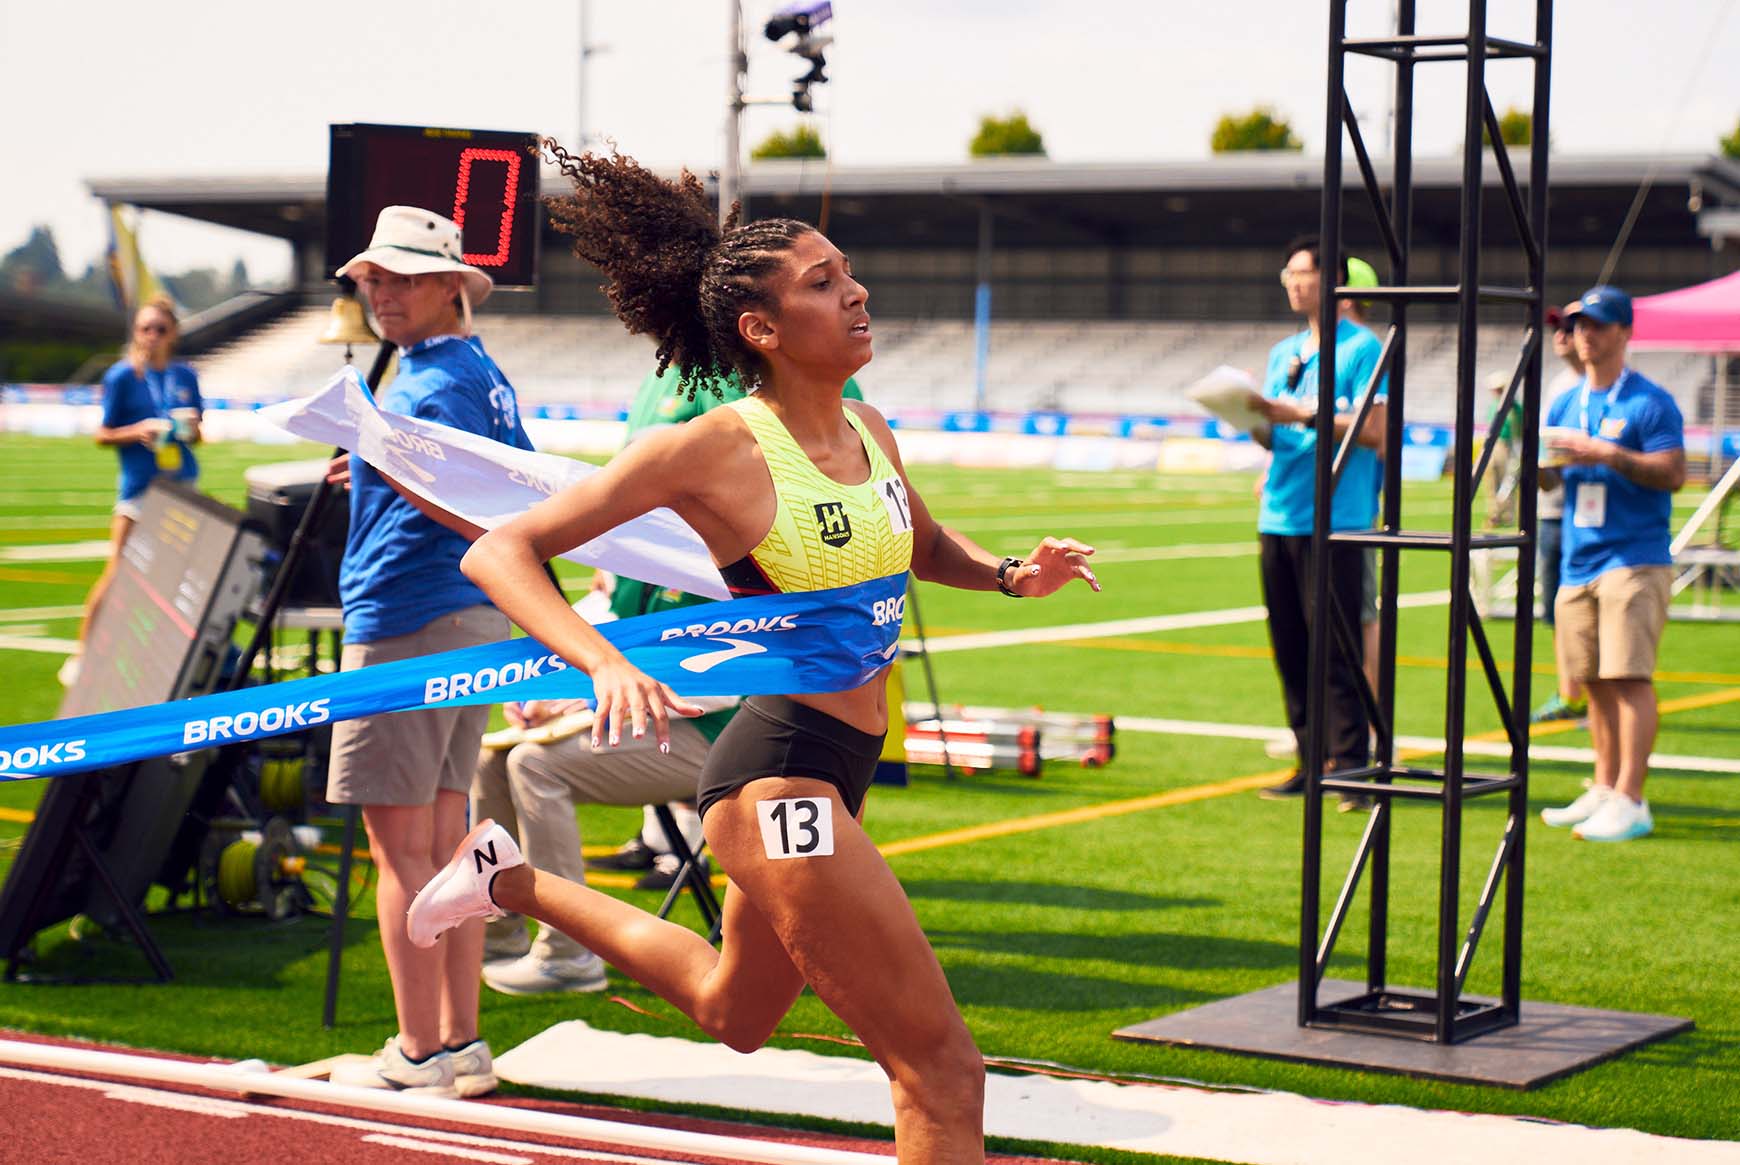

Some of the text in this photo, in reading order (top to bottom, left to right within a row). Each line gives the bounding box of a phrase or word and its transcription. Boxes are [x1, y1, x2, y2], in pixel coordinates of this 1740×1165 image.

[424, 654, 567, 704] BROOKS
[183, 698, 331, 745] BROOKS
[770, 800, 820, 854] 13
[473, 840, 498, 874] N
